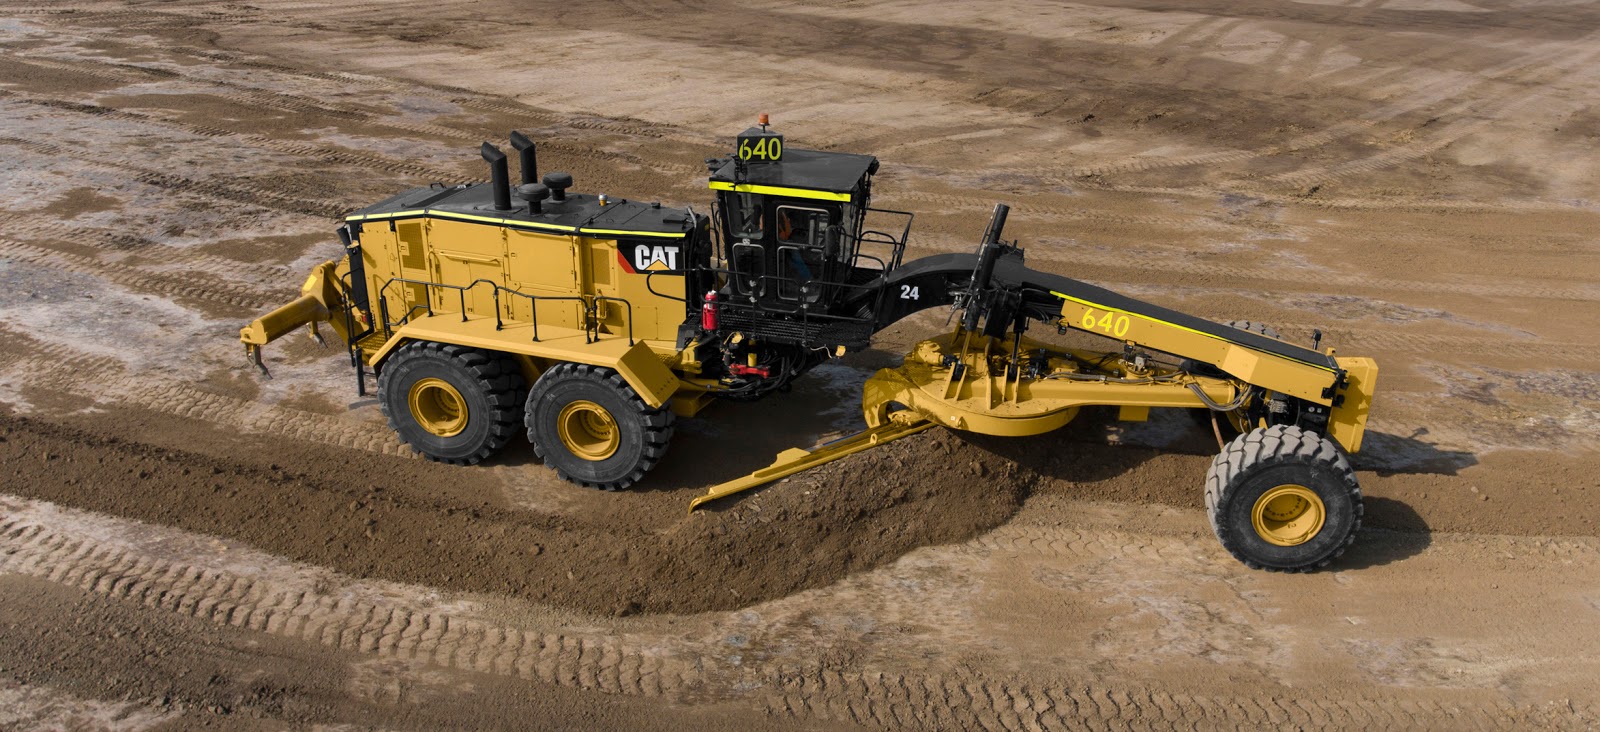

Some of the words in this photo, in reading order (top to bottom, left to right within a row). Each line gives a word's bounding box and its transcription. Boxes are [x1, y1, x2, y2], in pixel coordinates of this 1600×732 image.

[739, 138, 781, 160] 640
[635, 245, 679, 270] CAT
[901, 285, 919, 300] 24
[1082, 308, 1130, 337] 640
